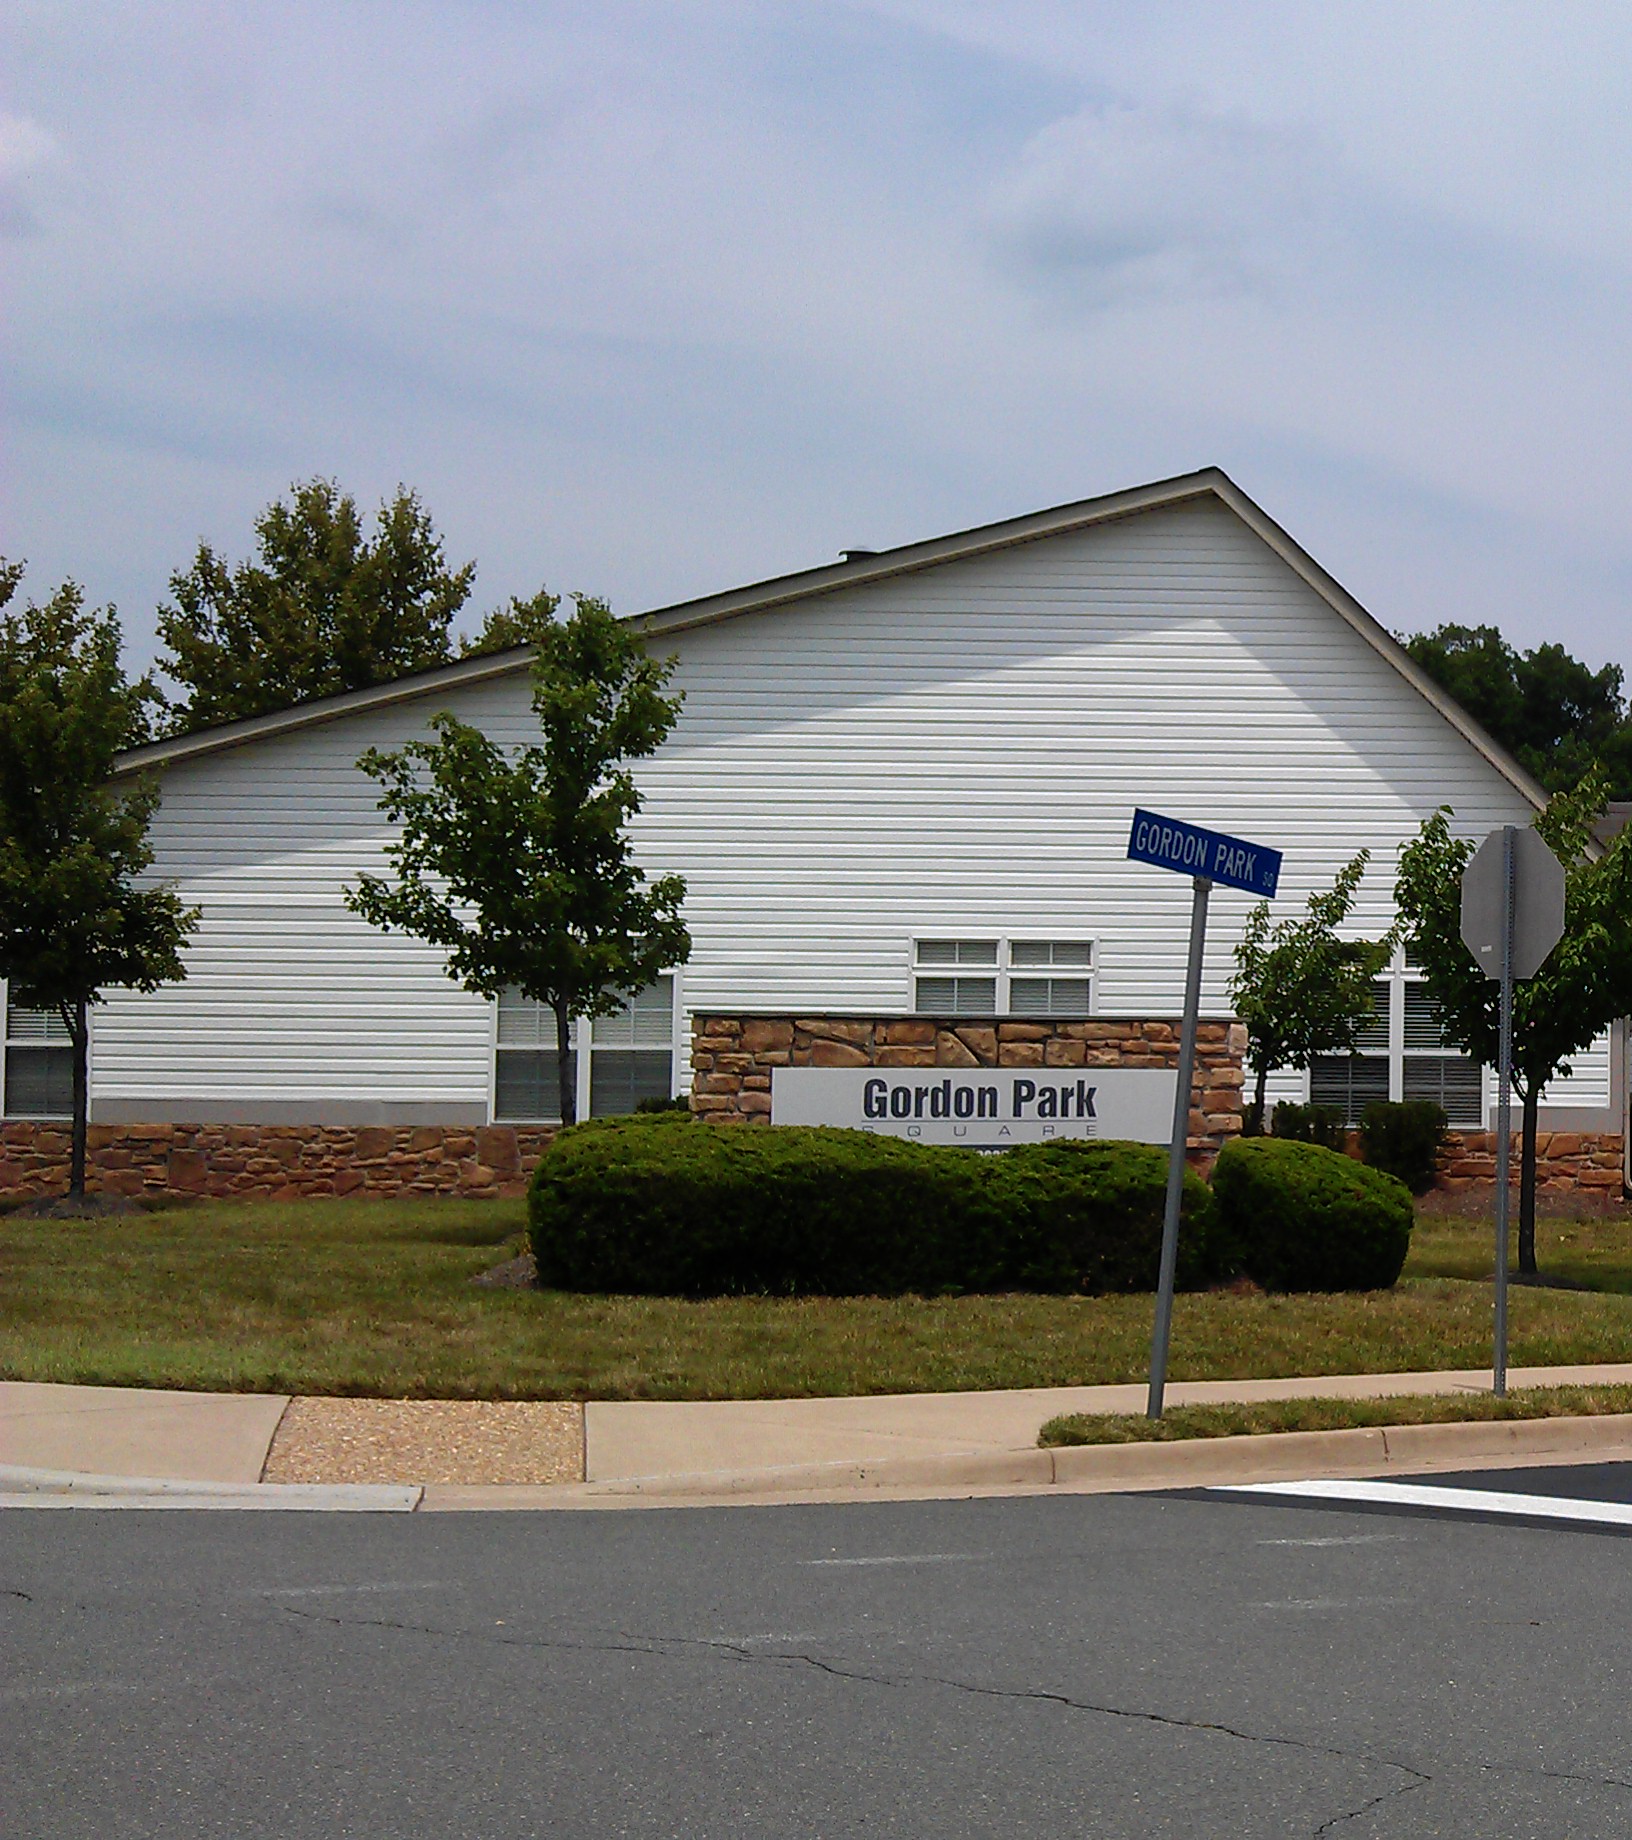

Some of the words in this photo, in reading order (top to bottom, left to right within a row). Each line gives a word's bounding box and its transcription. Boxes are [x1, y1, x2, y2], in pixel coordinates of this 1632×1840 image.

[1135, 820, 1208, 868] GORDON
[1214, 844, 1257, 882] PARK
[863, 1078, 998, 1118] Gordon
[1012, 1079, 1097, 1118] Park
